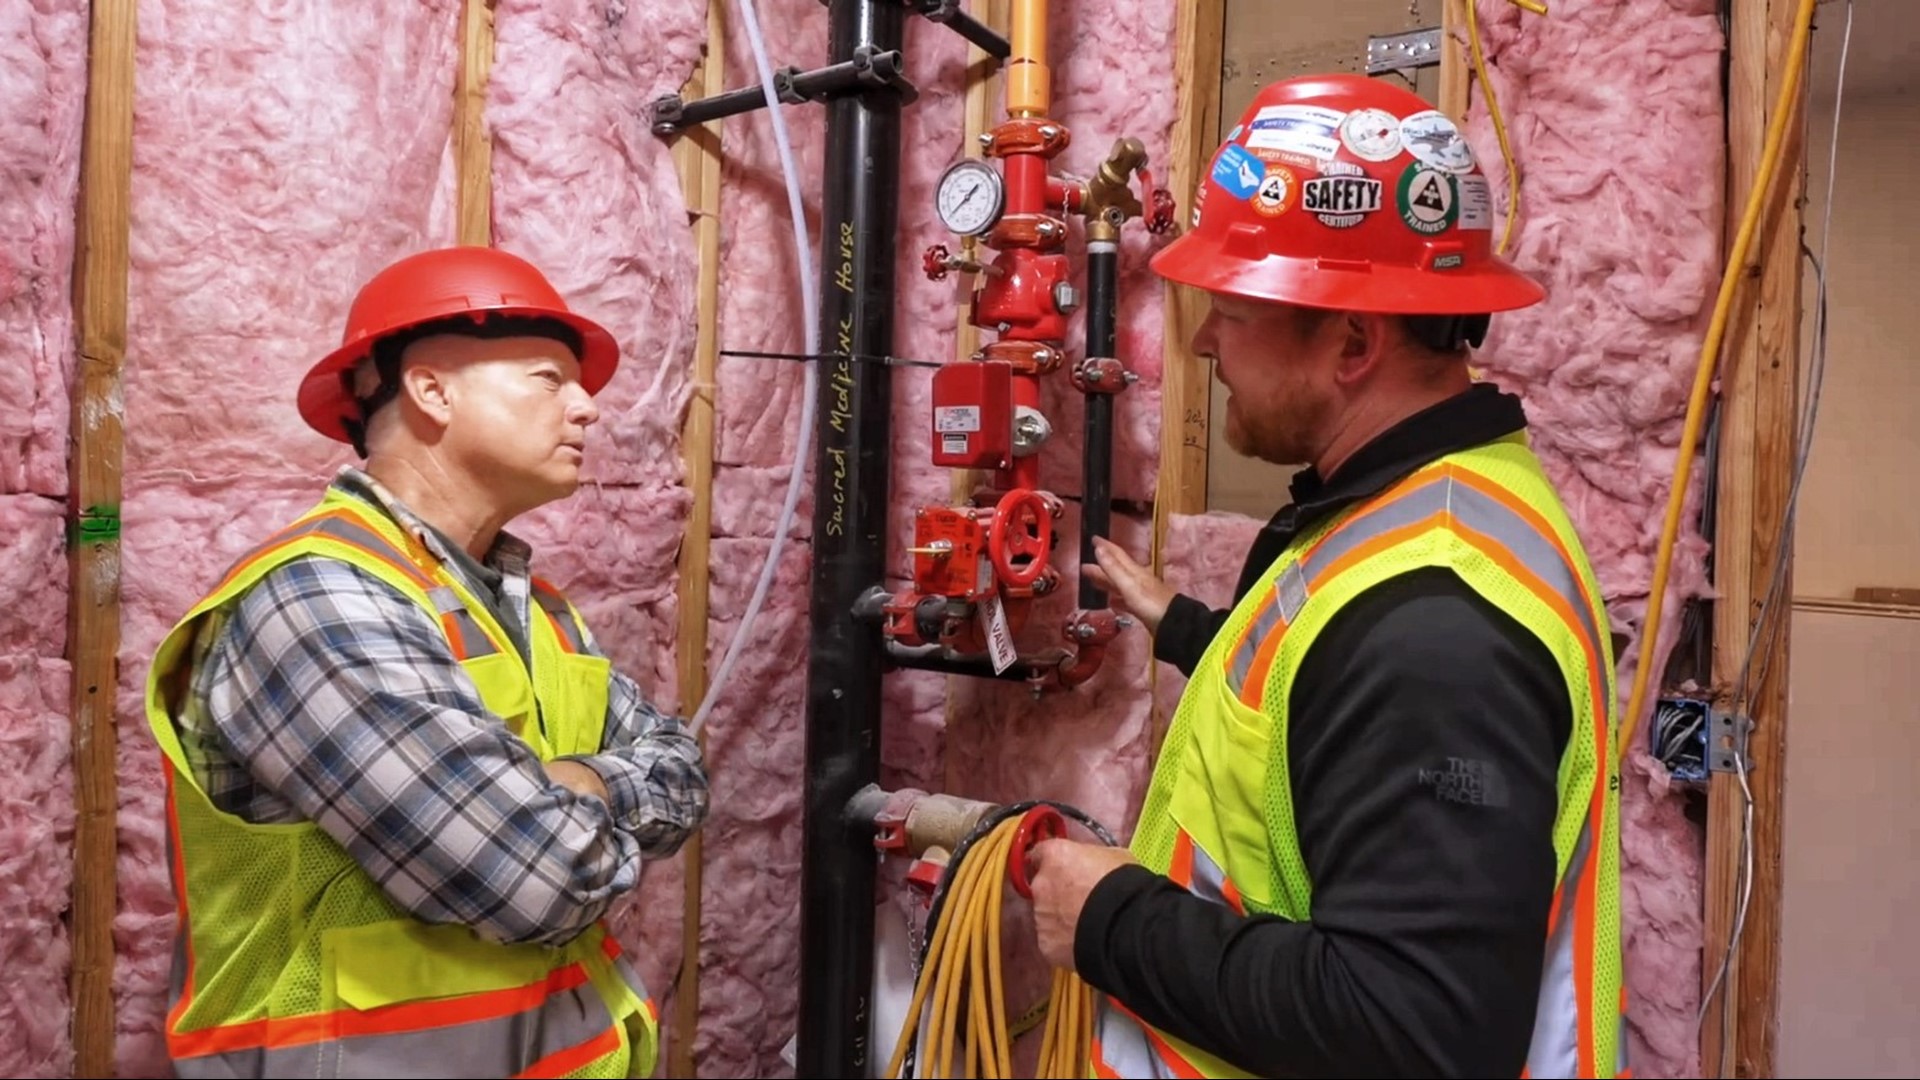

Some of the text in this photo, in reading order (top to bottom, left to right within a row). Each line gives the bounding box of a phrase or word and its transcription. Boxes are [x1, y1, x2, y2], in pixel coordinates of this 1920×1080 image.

[1305, 179, 1380, 212] SAFETY
[1404, 209, 1447, 232] TRAINED
[835, 220, 854, 292] House
[1434, 255, 1461, 268] MSA
[826, 447, 845, 536] Sacred
[992, 623, 1009, 663] VALVE
[1447, 757, 1481, 774] THE
[1418, 768, 1481, 790] NORTH
[1436, 786, 1481, 805] FACE
